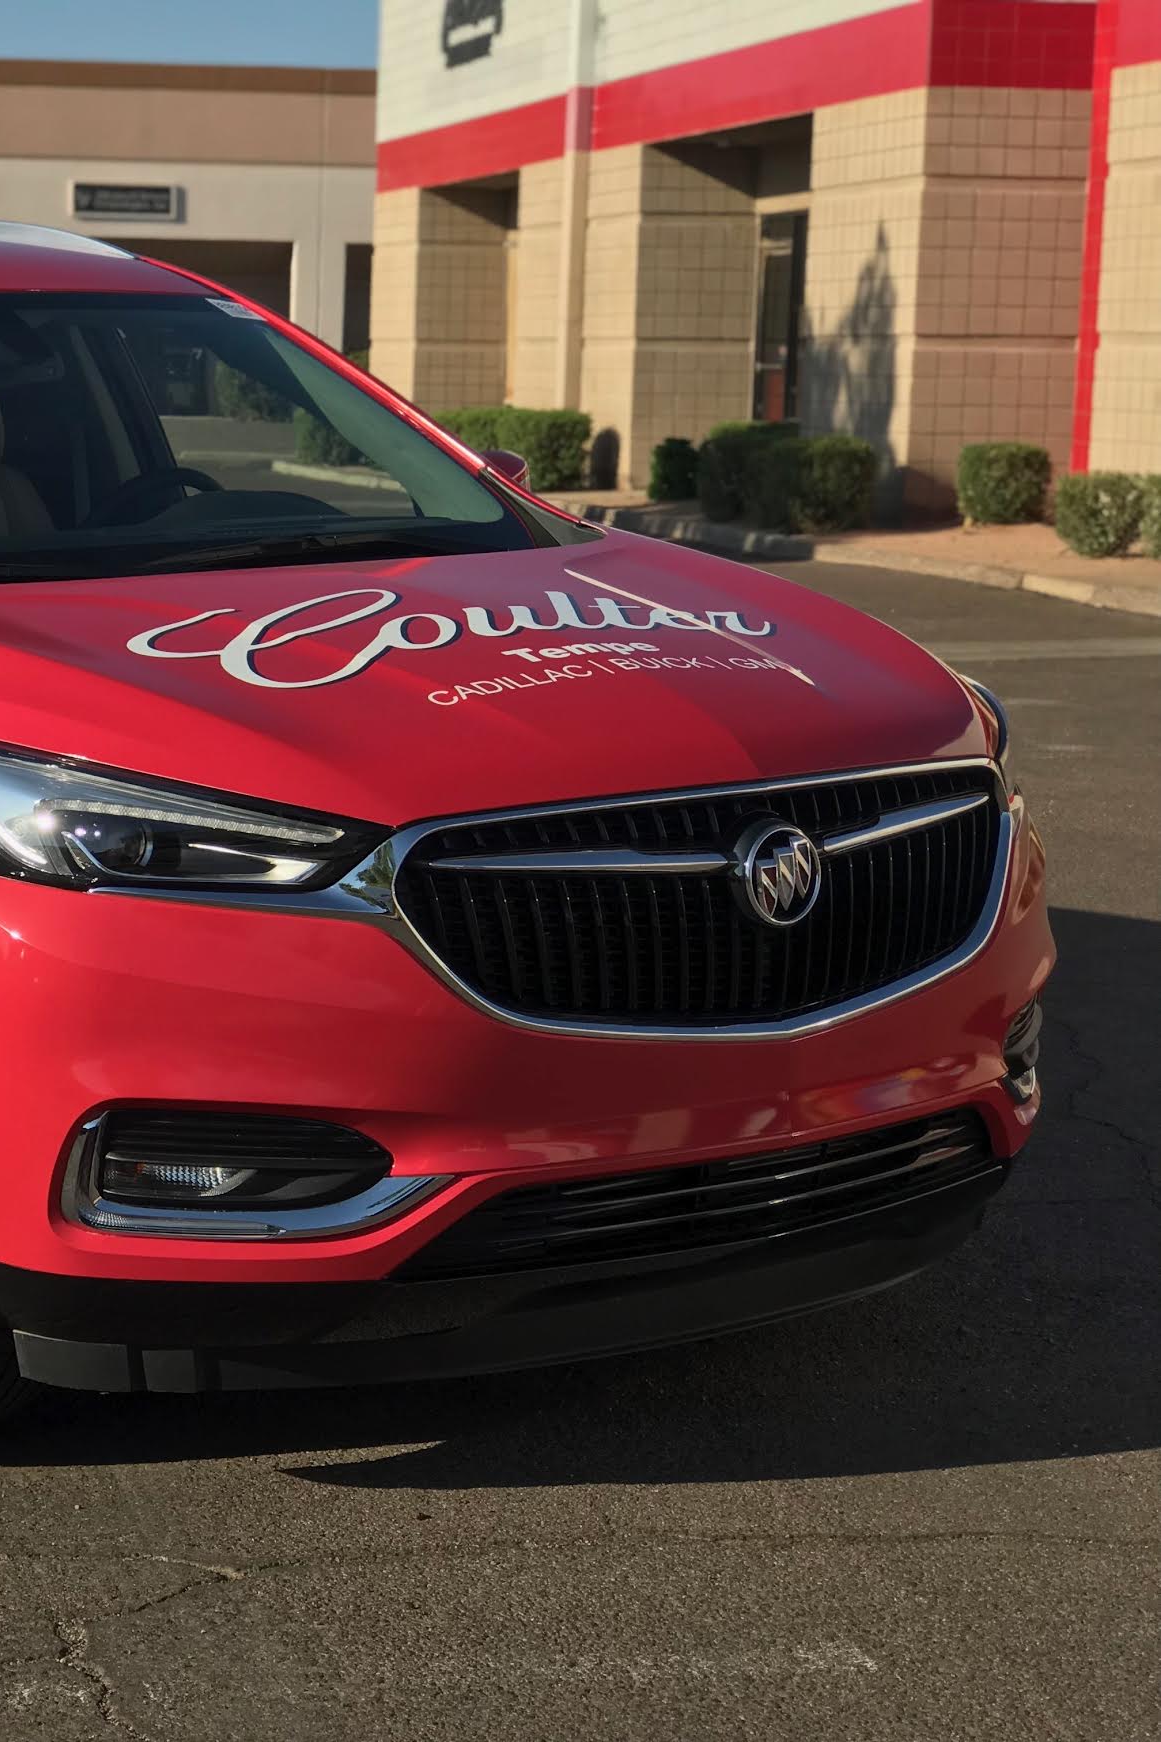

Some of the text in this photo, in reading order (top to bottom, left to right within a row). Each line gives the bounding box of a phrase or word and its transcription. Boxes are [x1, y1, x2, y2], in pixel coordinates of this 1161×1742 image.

[126, 588, 776, 688] Coulter
[502, 640, 660, 664] Tempe
[427, 664, 592, 706] CADILLAC
[607, 656, 700, 671] BUICK
